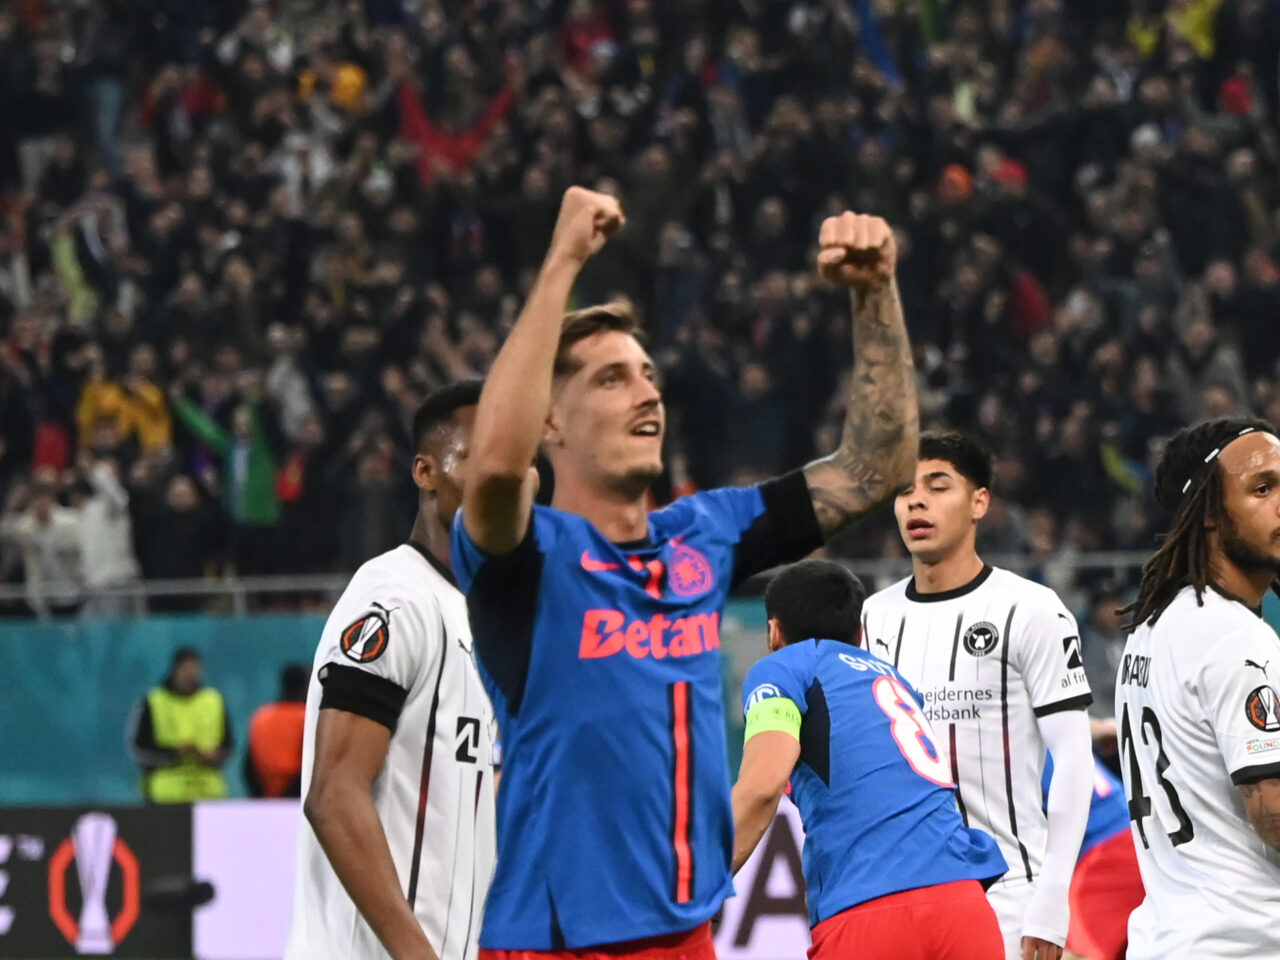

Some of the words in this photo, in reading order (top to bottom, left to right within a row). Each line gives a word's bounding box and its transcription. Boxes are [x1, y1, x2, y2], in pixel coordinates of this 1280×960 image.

[579, 609, 721, 660] Betan
[924, 704, 981, 721] dsbank
[925, 686, 992, 705] ejdernes
[1121, 702, 1194, 849] 43
